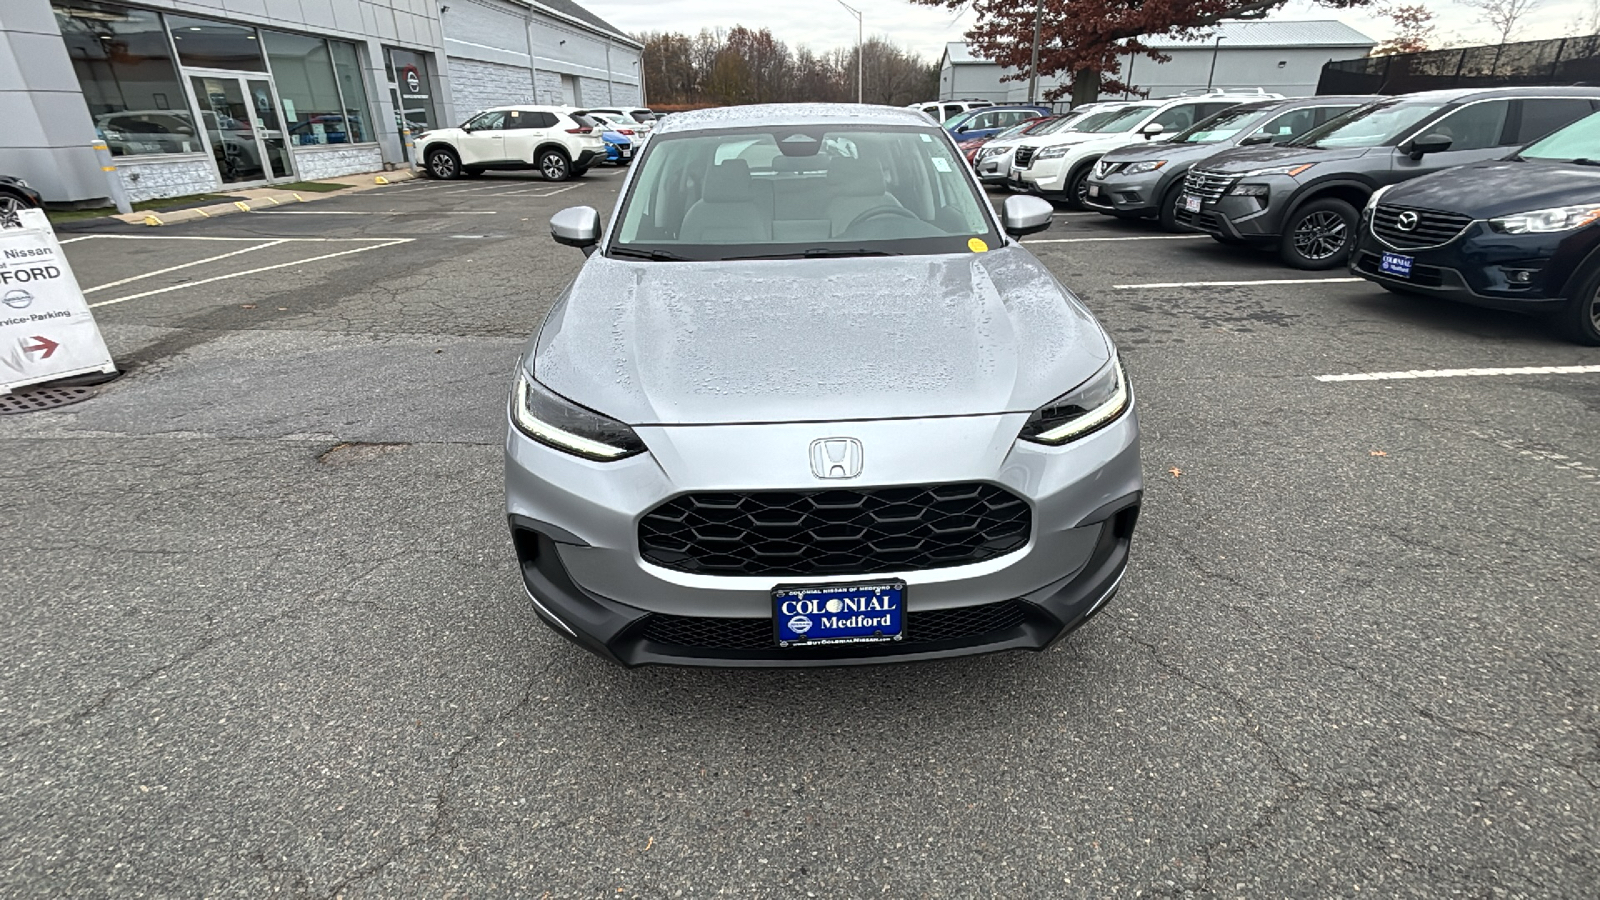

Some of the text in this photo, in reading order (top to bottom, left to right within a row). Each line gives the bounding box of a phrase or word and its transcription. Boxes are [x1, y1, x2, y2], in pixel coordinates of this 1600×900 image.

[3, 247, 54, 259] Nissan
[0, 266, 61, 285] FORD
[788, 588, 822, 596] COLONIAL
[781, 596, 896, 616] COLONIAL
[821, 614, 891, 629] Medford
